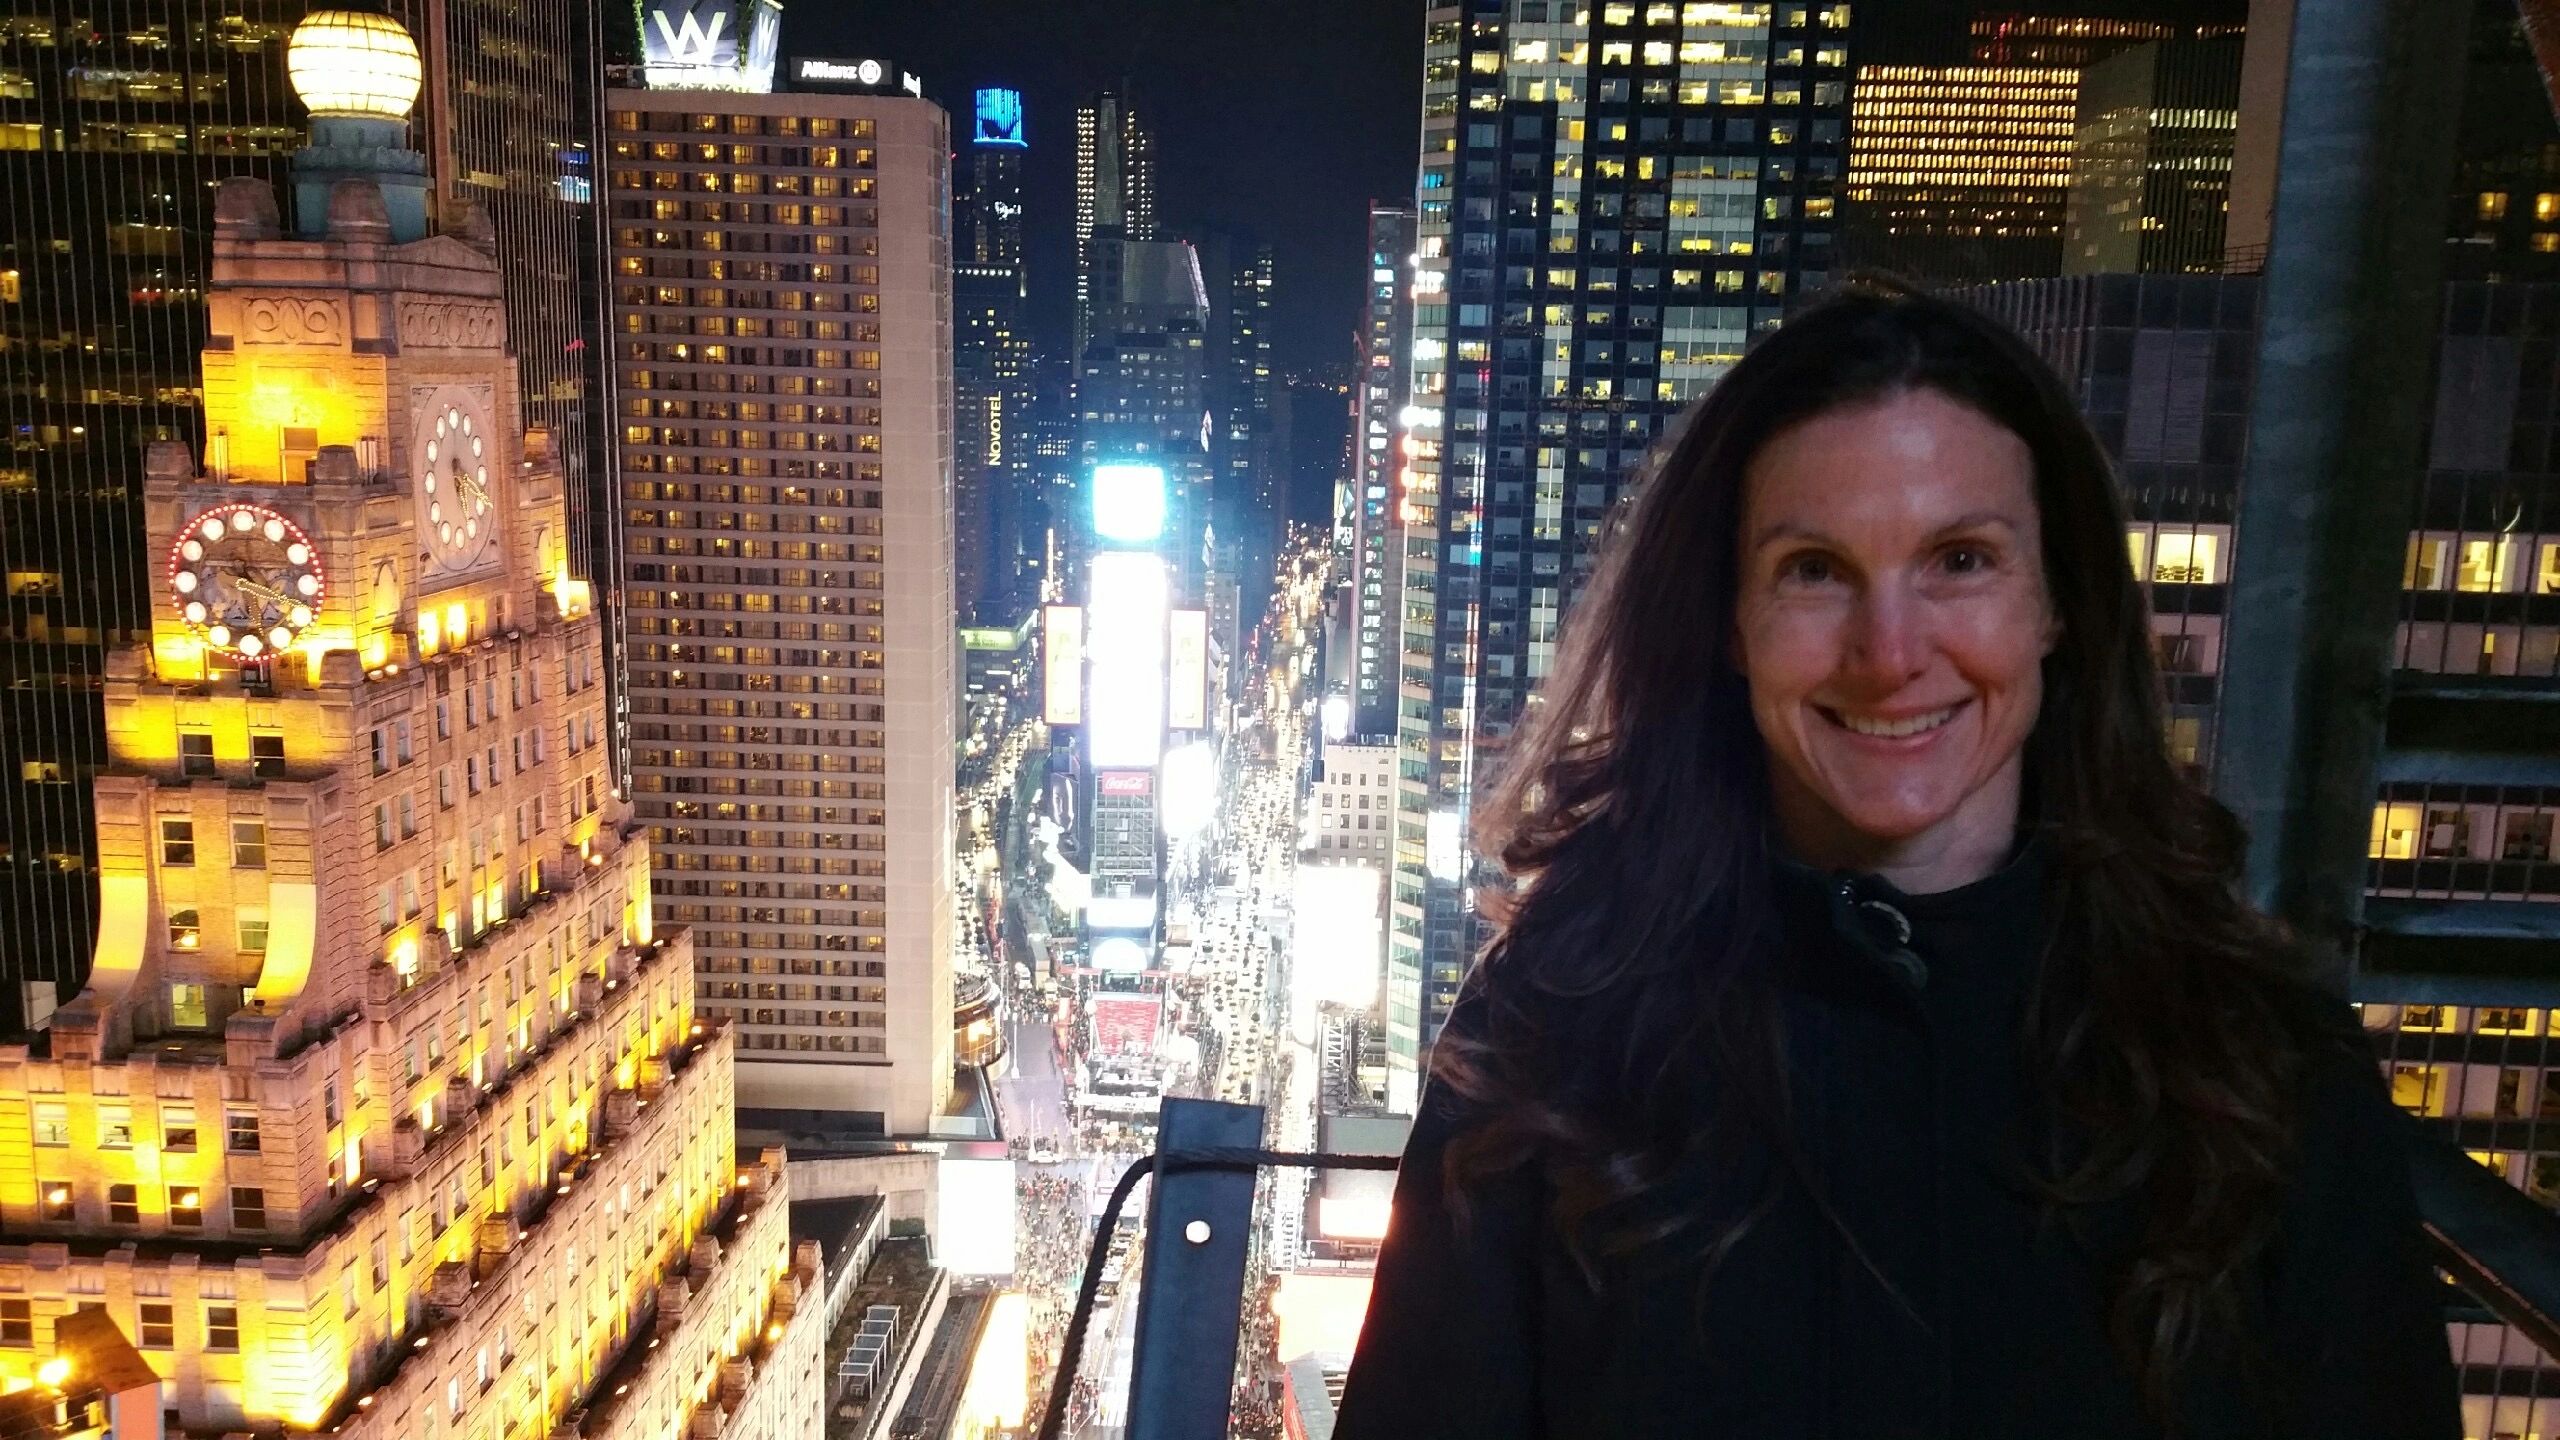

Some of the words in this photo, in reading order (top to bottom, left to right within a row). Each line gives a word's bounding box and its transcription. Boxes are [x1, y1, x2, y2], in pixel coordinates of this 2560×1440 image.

[652, 10, 727, 61] W
[757, 12, 776, 57] W
[801, 60, 858, 79] Allianz
[988, 390, 1002, 466] NOVOTEL
